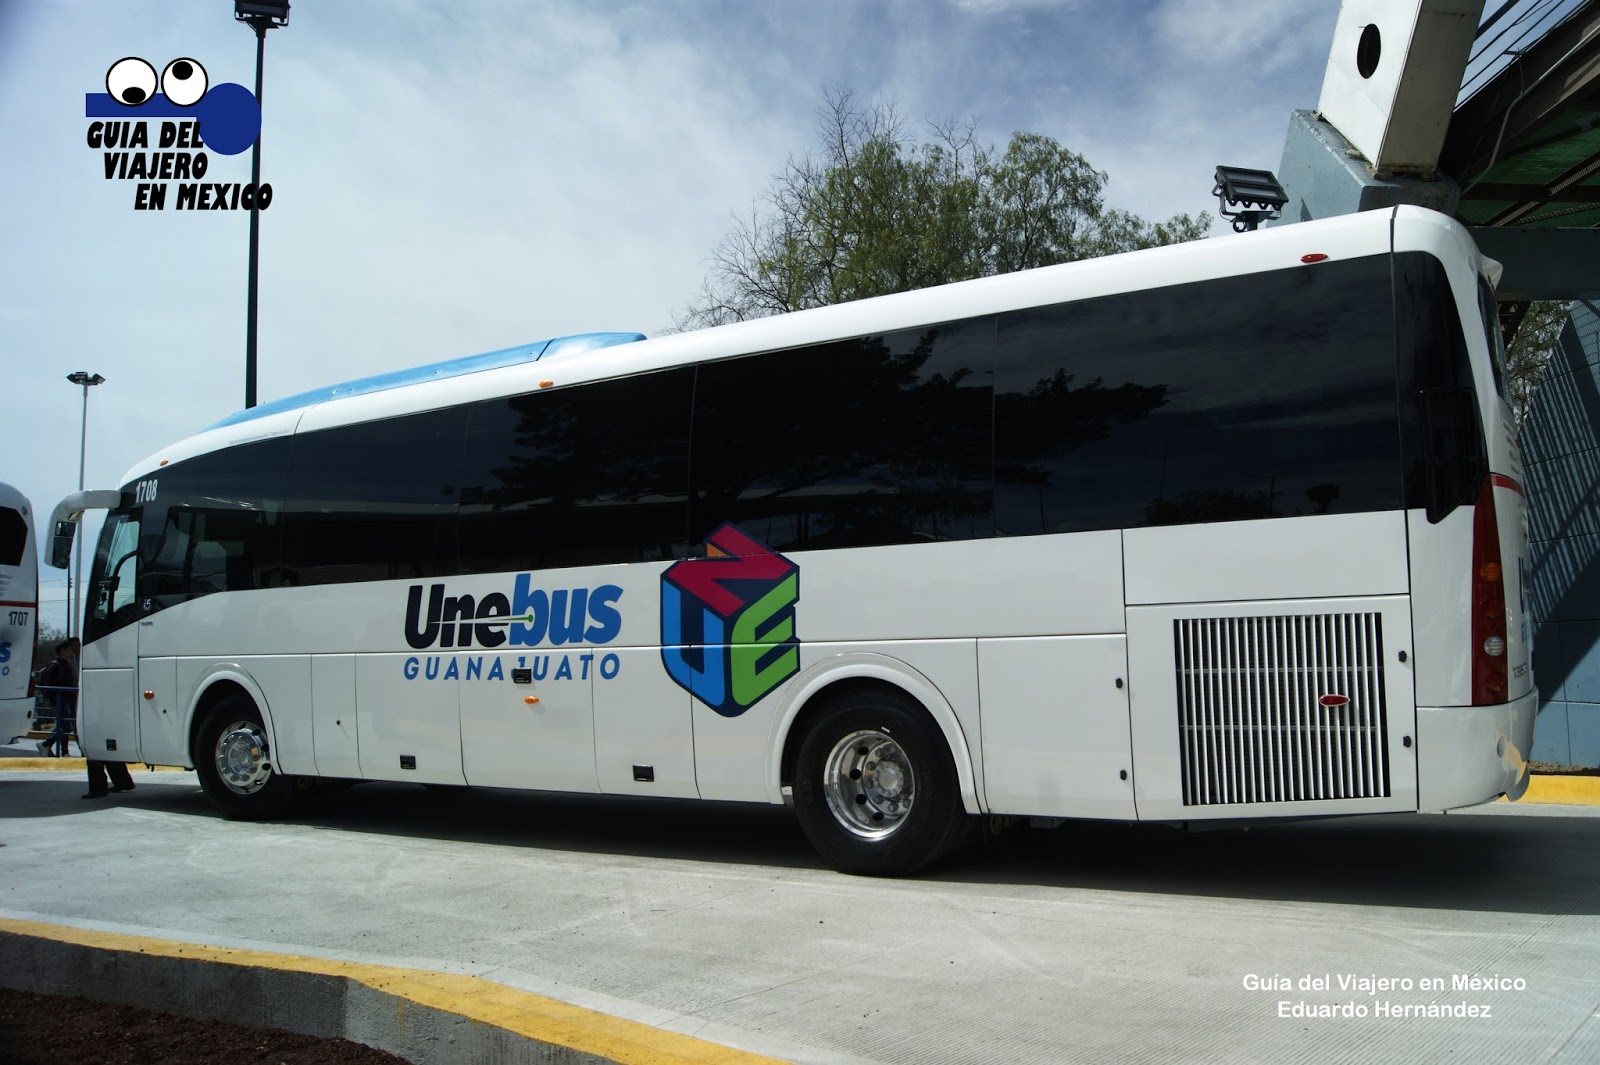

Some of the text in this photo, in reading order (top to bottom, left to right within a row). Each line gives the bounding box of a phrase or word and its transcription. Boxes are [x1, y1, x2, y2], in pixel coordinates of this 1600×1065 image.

[136, 479, 158, 503] 1708
[8, 611, 29, 626] 1707
[405, 573, 624, 649] Unebus
